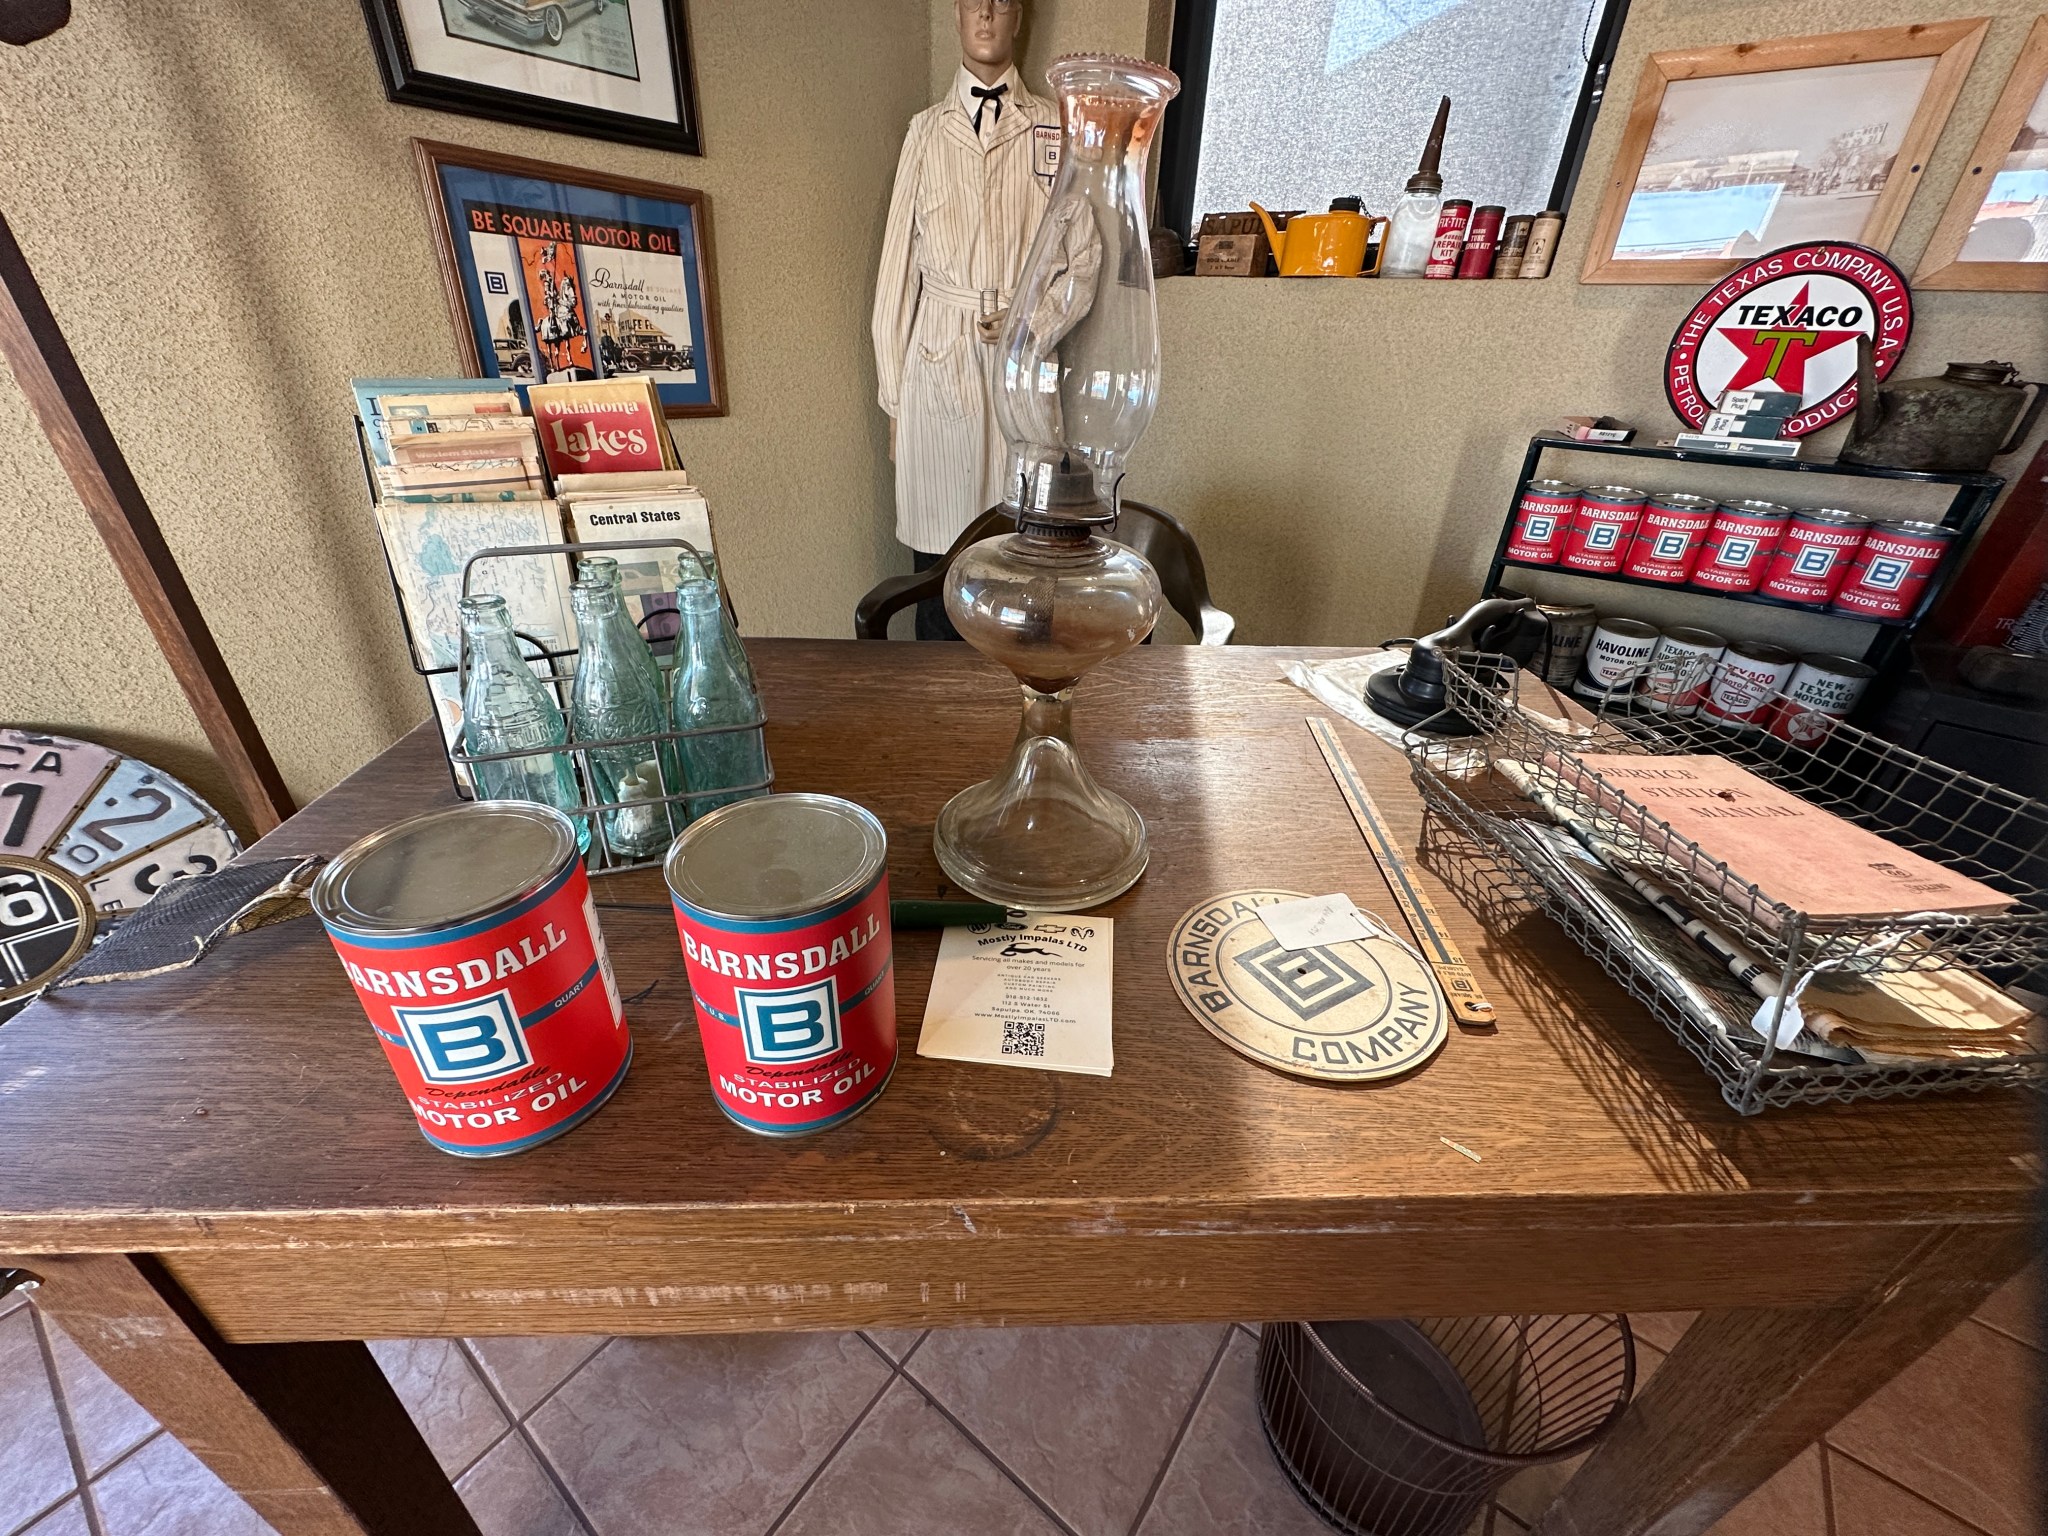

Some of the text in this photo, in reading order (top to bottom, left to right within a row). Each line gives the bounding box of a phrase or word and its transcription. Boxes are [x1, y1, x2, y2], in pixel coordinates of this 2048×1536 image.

[1036, 131, 1060, 141] BARNSD
[1049, 152, 1057, 160] B
[471, 209, 676, 253] BE SQUARE MOTOR OIL
[1440, 249, 1454, 257] KIT
[589, 268, 645, 292] Barnsdall
[1679, 310, 1711, 348] THE
[1708, 259, 1784, 307] TEXAS
[1793, 251, 1896, 295] COMPANY
[1737, 305, 1863, 327] TEXACO
[1752, 331, 1819, 379] T
[1674, 364, 1704, 426] PETROL
[1731, 396, 1749, 404] Spark
[544, 399, 639, 416] Oklahoma
[1730, 402, 1744, 411] Plug
[550, 418, 648, 463] Lakes
[1519, 499, 1573, 514] BARNSDALL
[1581, 506, 1639, 522] BARNSDALL
[589, 510, 681, 527] Central States
[1647, 513, 1710, 530] BARNSDALL
[1714, 518, 1780, 537] BARNSDALL
[1529, 520, 1550, 537] B
[1592, 527, 1614, 545] B
[1789, 527, 1860, 547] BARNSDALL
[1507, 546, 1554, 559] MOTOR OIL
[1659, 536, 1683, 554] B
[1723, 541, 1750, 562] B
[1864, 536, 1941, 559] BARNSDALL
[1568, 554, 1617, 567] MOTOR OIL
[1799, 551, 1829, 571] B
[1632, 564, 1684, 577] MOTOR OIL
[1696, 570, 1751, 586] MOTOR OIL
[1870, 563, 1902, 584] B
[1768, 580, 1828, 597] MOTOR OIL
[1840, 591, 1901, 611] MOTOR OIL
[1552, 635, 1583, 648] LINE
[1595, 638, 1650, 658] HAVOLINE
[1599, 655, 1625, 665] MOTOR
[1602, 669, 1621, 678] TEXA
[1750, 685, 1764, 693] OIL
[1799, 682, 1854, 702] TEXACO
[1817, 678, 1844, 691] NEW
[1793, 690, 1848, 710] MOTOR OIL
[1597, 767, 1700, 780] SERVICE
[1640, 787, 1753, 799] STATION
[81, 788, 172, 851] 2
[1689, 806, 1806, 818] MANUAL
[682, 913, 881, 981] BARNSDALL
[977, 933, 1087, 952] Mostly Impalas LTD
[553, 979, 585, 1008] QUART
[756, 999, 824, 1052] B
[1292, 981, 1430, 1065] COMPANY
[418, 1015, 507, 1071] B
[733, 1058, 861, 1090] STABILIZED
[745, 1051, 854, 1080] Dependable
[417, 1072, 563, 1109] STABILIZED
[424, 1066, 551, 1100] Dependable
[719, 1063, 876, 1108] MOTOR OIL
[412, 1076, 588, 1129] MOTOR OIL
